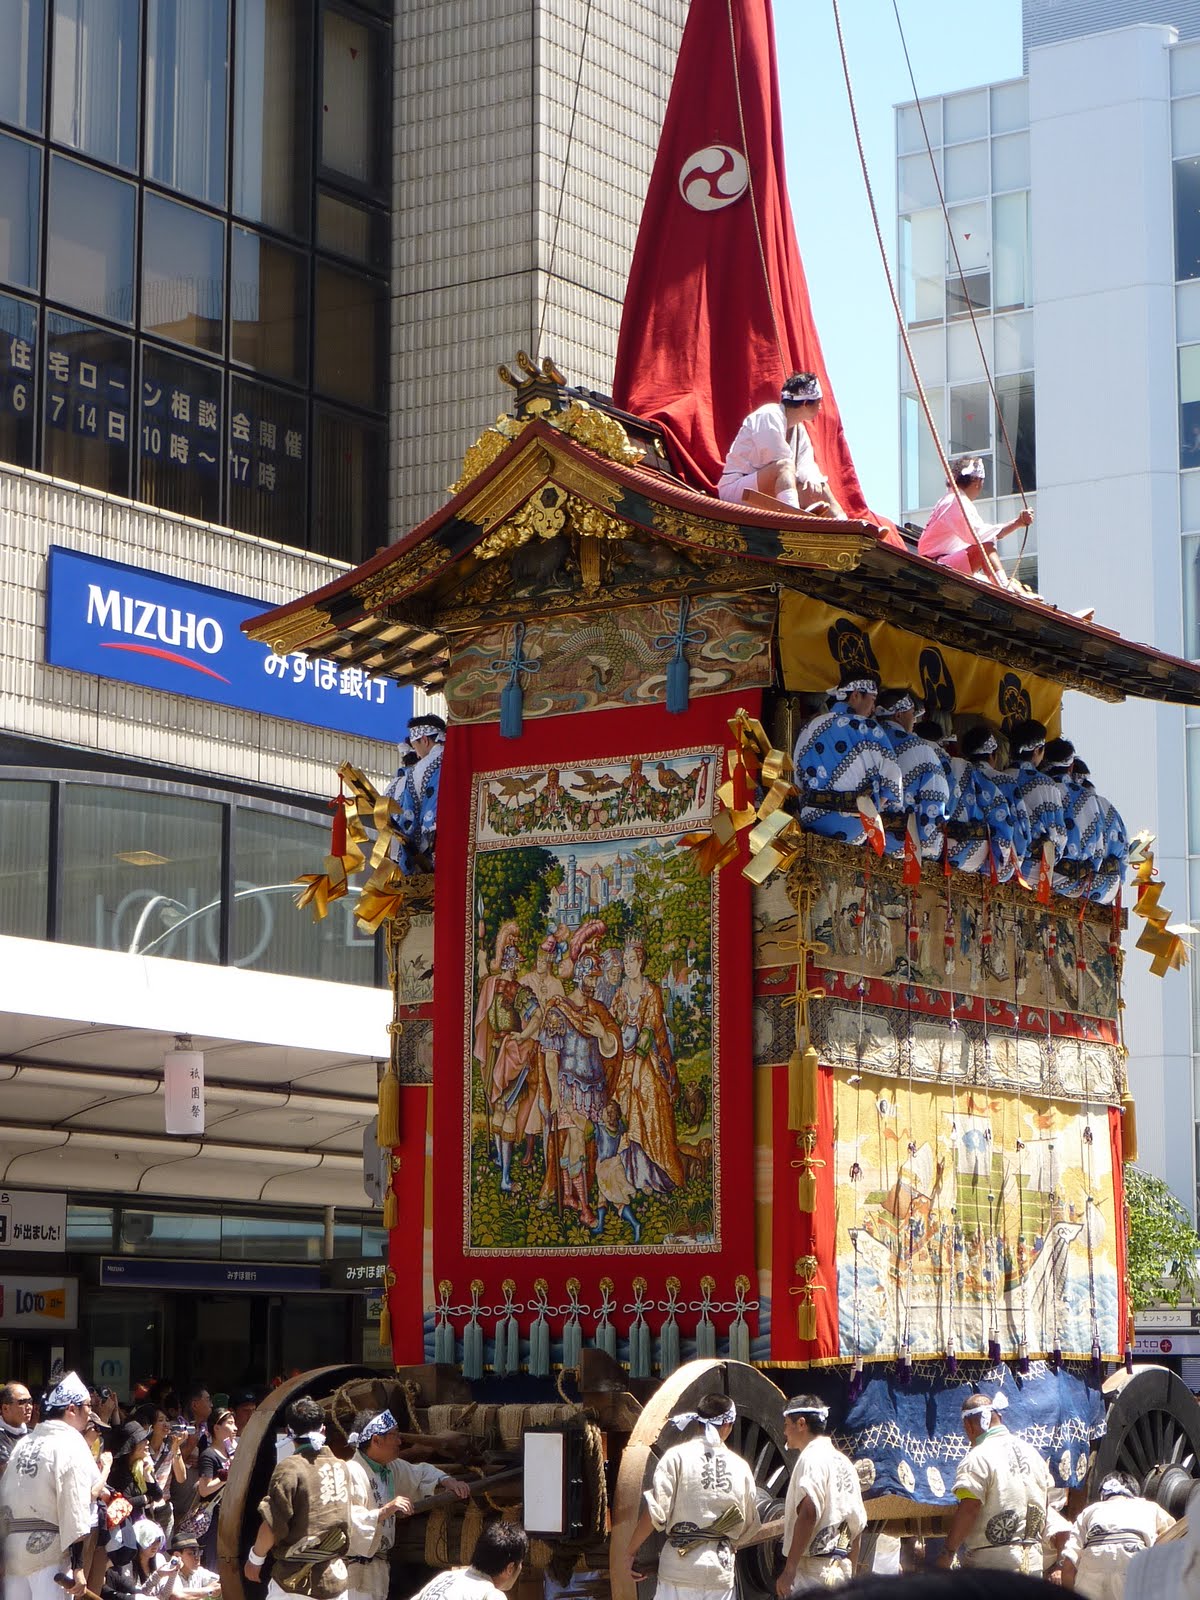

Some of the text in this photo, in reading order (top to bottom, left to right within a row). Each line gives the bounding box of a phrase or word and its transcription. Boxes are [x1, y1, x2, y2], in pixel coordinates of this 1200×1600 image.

[10, 338, 302, 459] 住宅ローン相談会開催
[87, 584, 224, 654] MIZUHO
[264, 651, 388, 704] みずほ銀行
[190, 1067, 200, 1118] 祇園祭
[16, 1289, 45, 1314] LOTO
